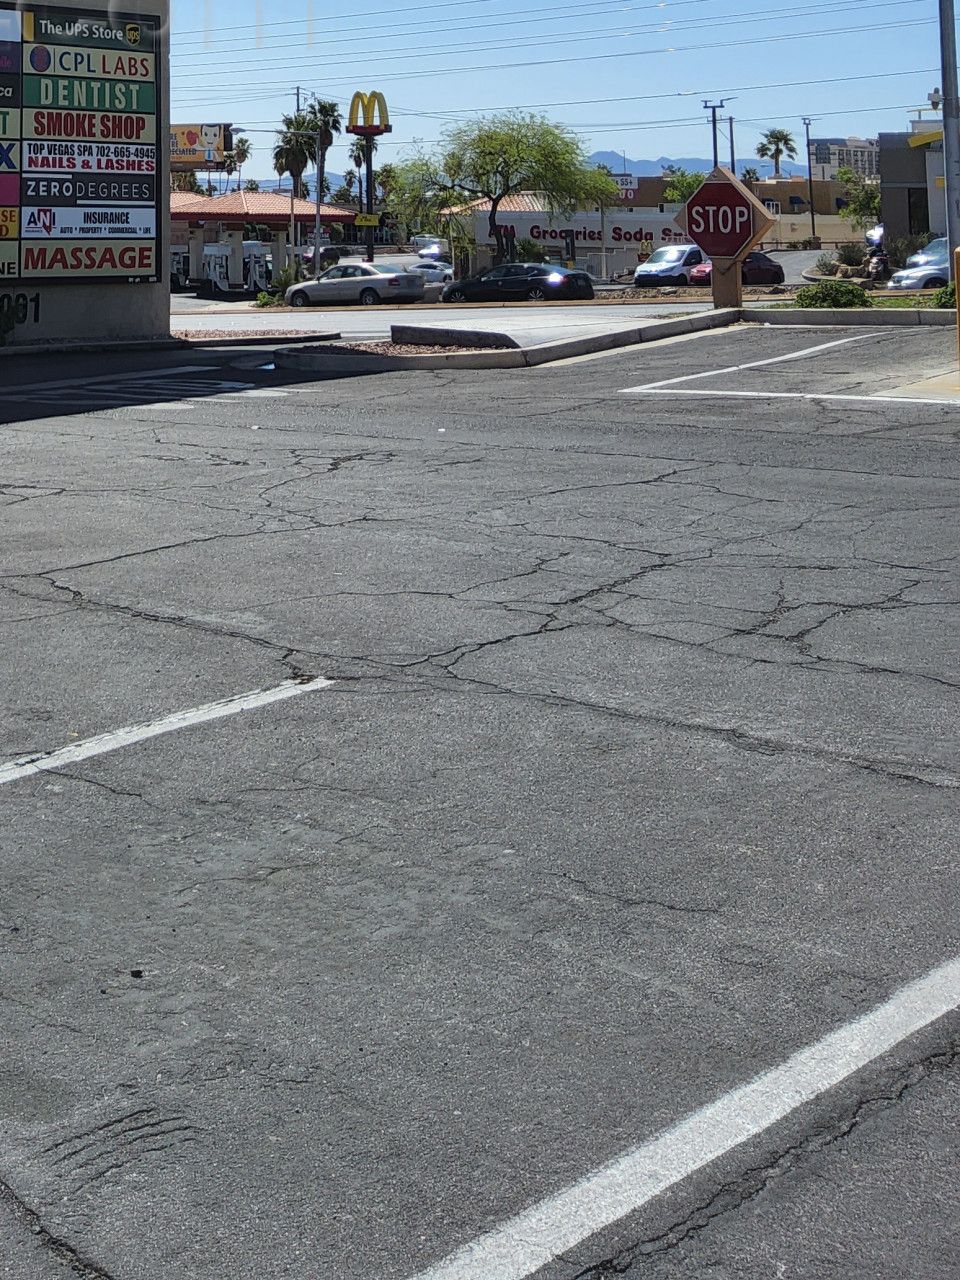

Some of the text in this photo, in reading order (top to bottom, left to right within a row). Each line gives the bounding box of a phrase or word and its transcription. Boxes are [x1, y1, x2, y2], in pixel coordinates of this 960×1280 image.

[40, 20, 124, 40] The UPS Store
[59, 51, 150, 77] CPL LABS
[40, 78, 140, 110] DENTIST
[33, 111, 146, 140] SMOKE SHOP
[27, 143, 156, 160] TOP VEGAS SPA 702-665-4945
[27, 156, 155, 172] NAILS & LASHES
[27, 210, 56, 227] ANI
[83, 211, 130, 224] INSURANCE
[691, 206, 748, 233] STOP
[60, 226, 73, 234] AUTO
[79, 226, 102, 234] PROPERTY
[529, 224, 602, 241] Grocries
[611, 226, 654, 242] Soda
[23, 246, 153, 270] MASSAGE
